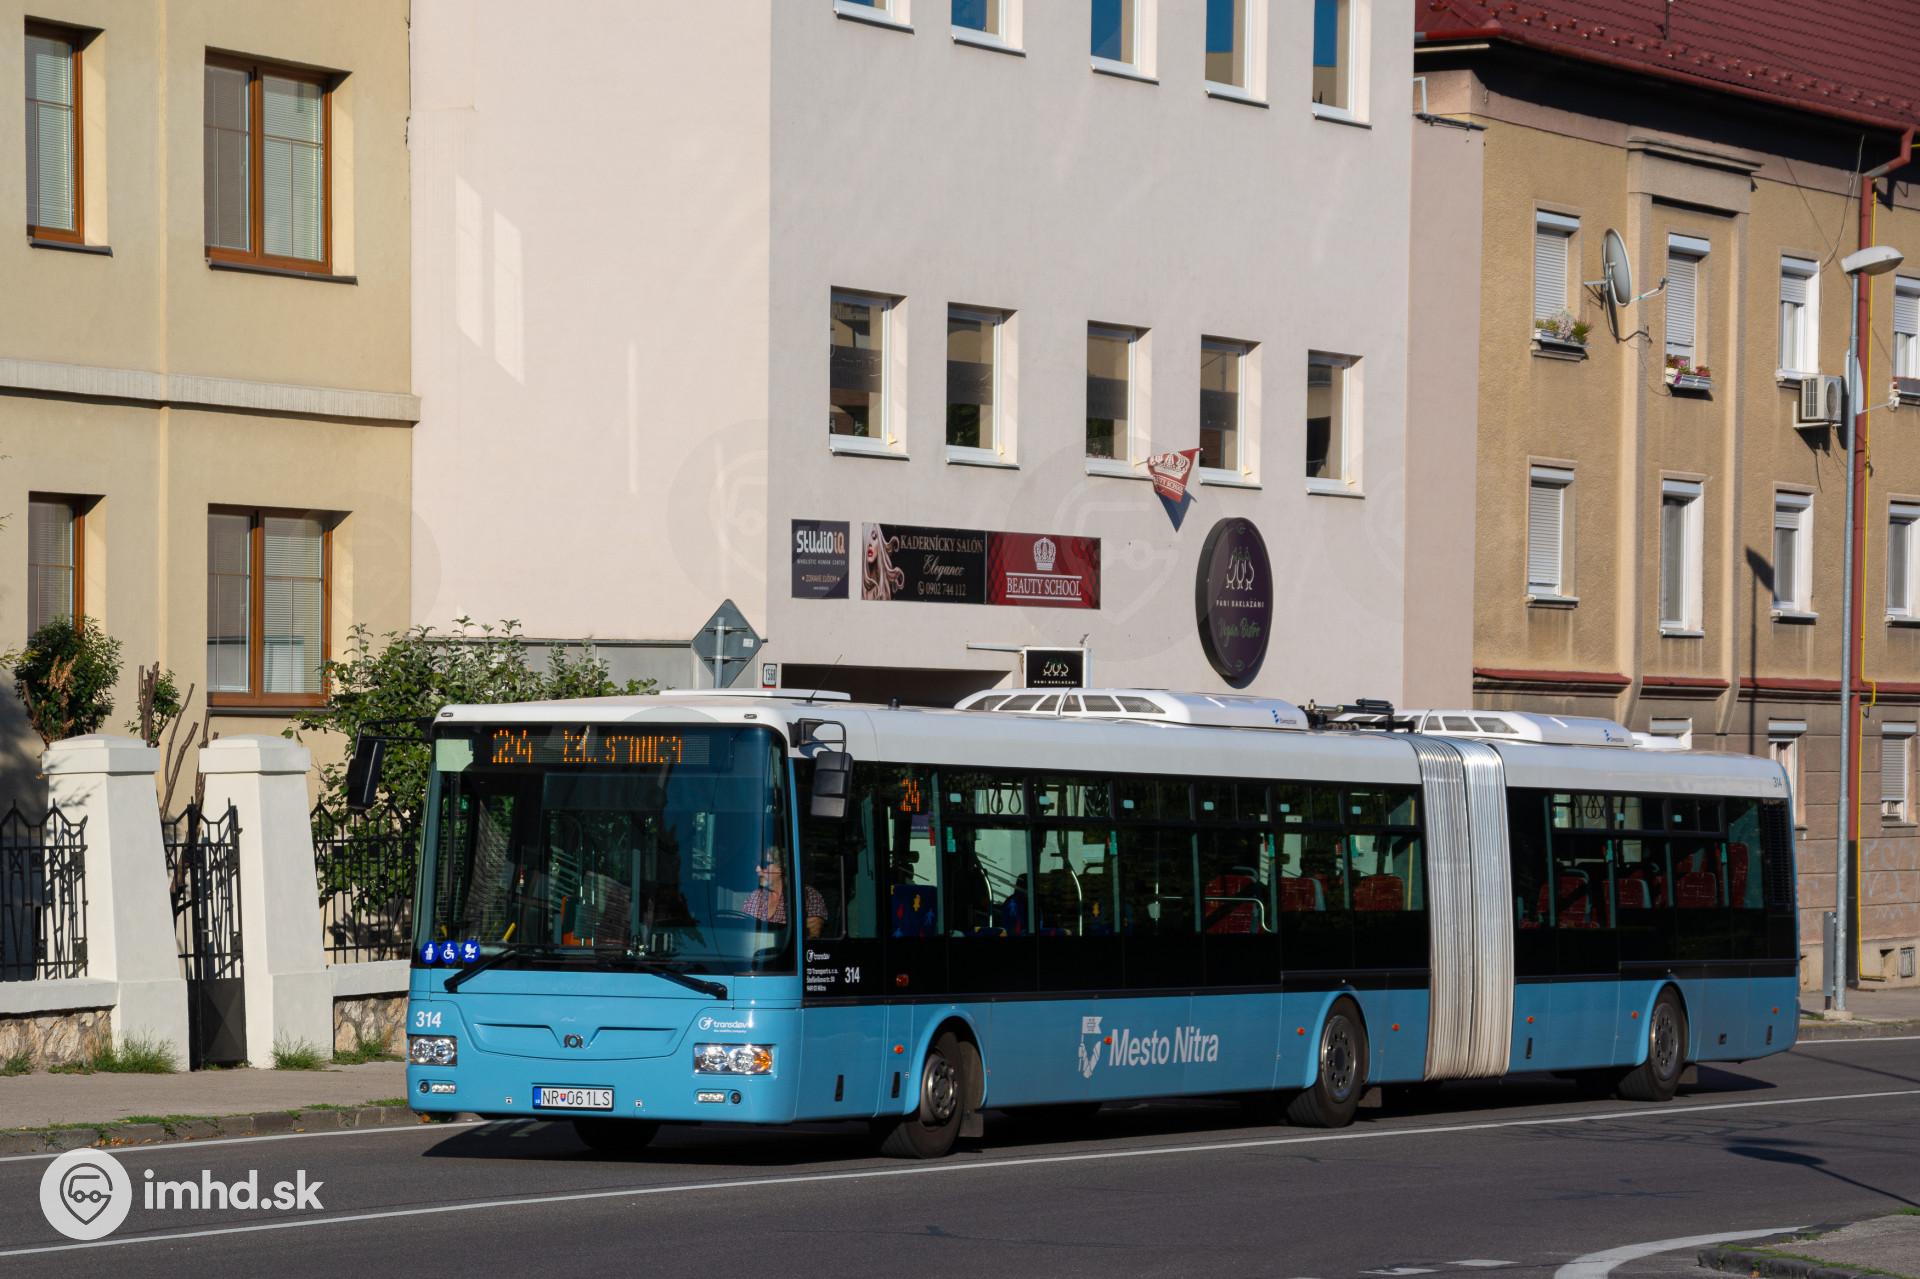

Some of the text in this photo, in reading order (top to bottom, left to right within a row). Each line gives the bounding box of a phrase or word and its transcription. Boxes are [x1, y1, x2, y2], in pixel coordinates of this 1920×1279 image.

[1006, 576, 1082, 597] BEAUTY SCHOOL
[492, 729, 532, 764] 24
[900, 778, 920, 812] 24
[844, 966, 861, 984] 314
[415, 1010, 442, 1029] 314
[1108, 1026, 1220, 1067] Mesto Nitra
